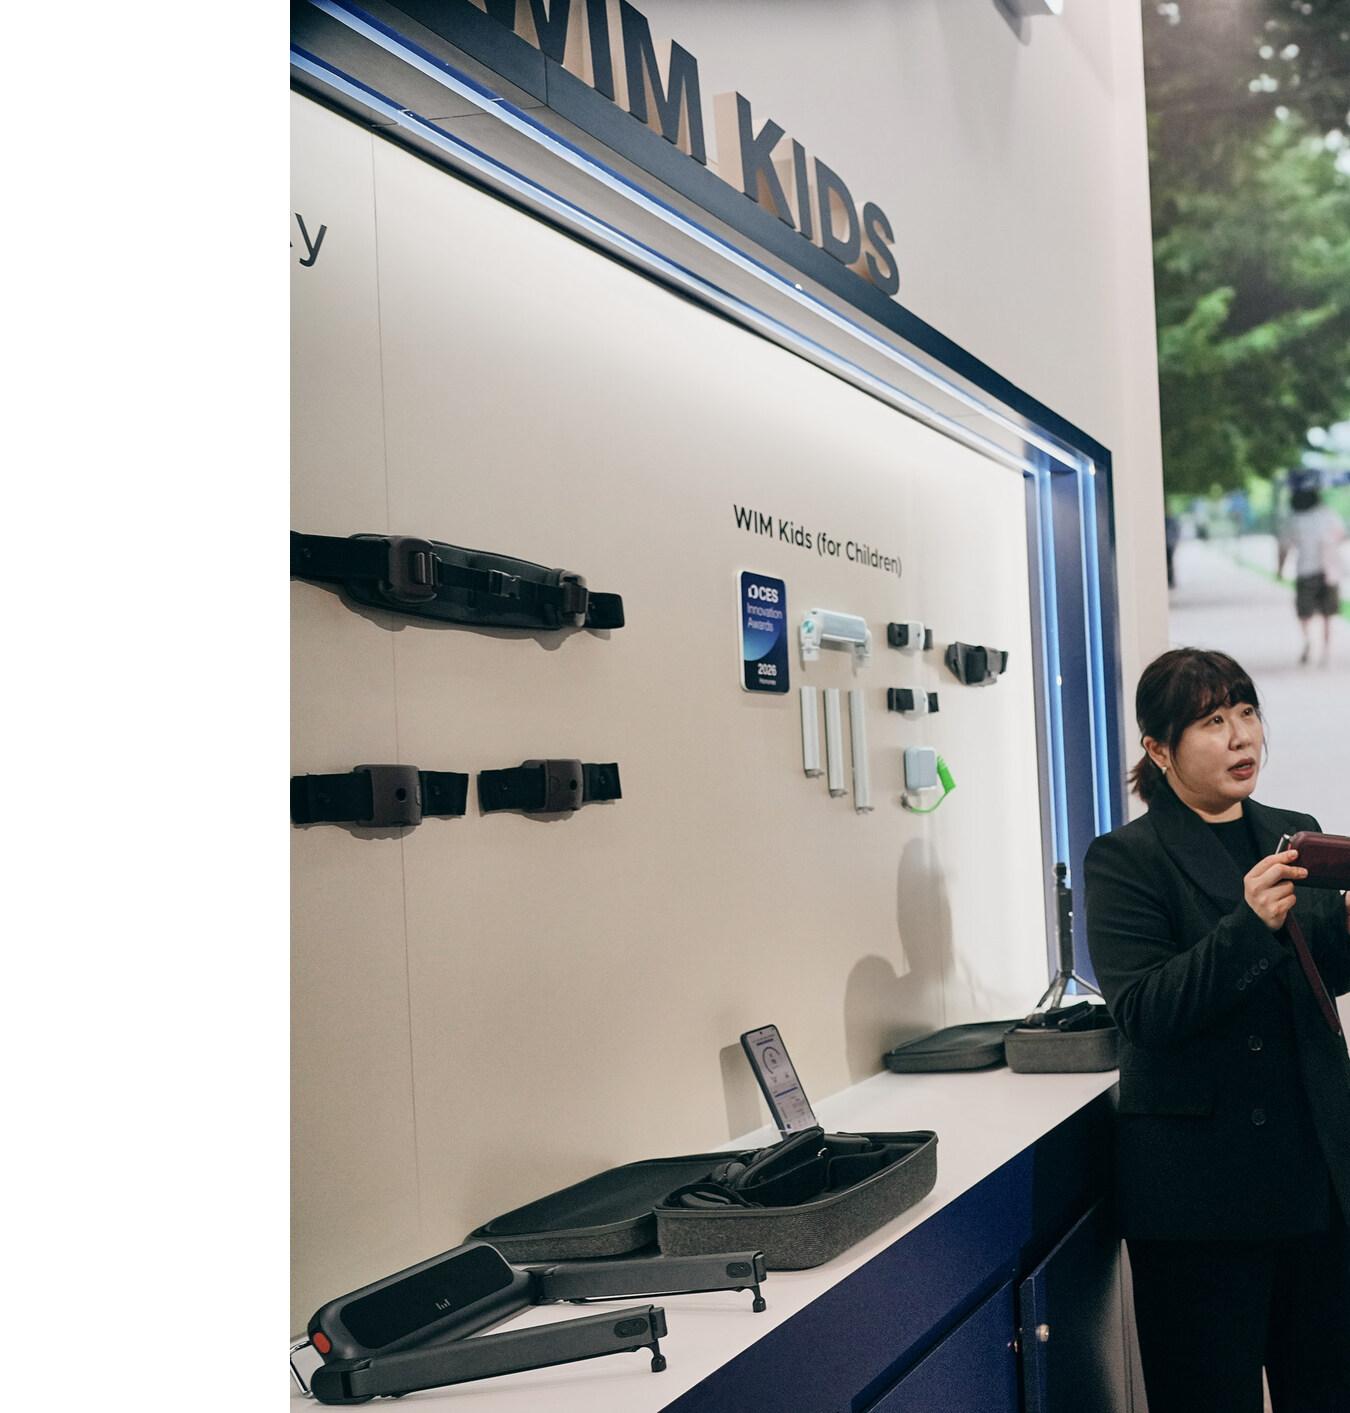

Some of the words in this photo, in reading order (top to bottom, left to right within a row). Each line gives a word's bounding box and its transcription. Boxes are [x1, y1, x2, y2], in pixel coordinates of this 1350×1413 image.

[734, 90, 901, 296] KIDS
[733, 503, 774, 538] WIM
[778, 518, 813, 550] Kids
[816, 531, 842, 557] (for
[845, 540, 903, 579] Children)
[758, 586, 779, 604] CES
[746, 602, 784, 620] Innovation
[747, 617, 775, 633] Awards
[757, 663, 777, 677] 2026
